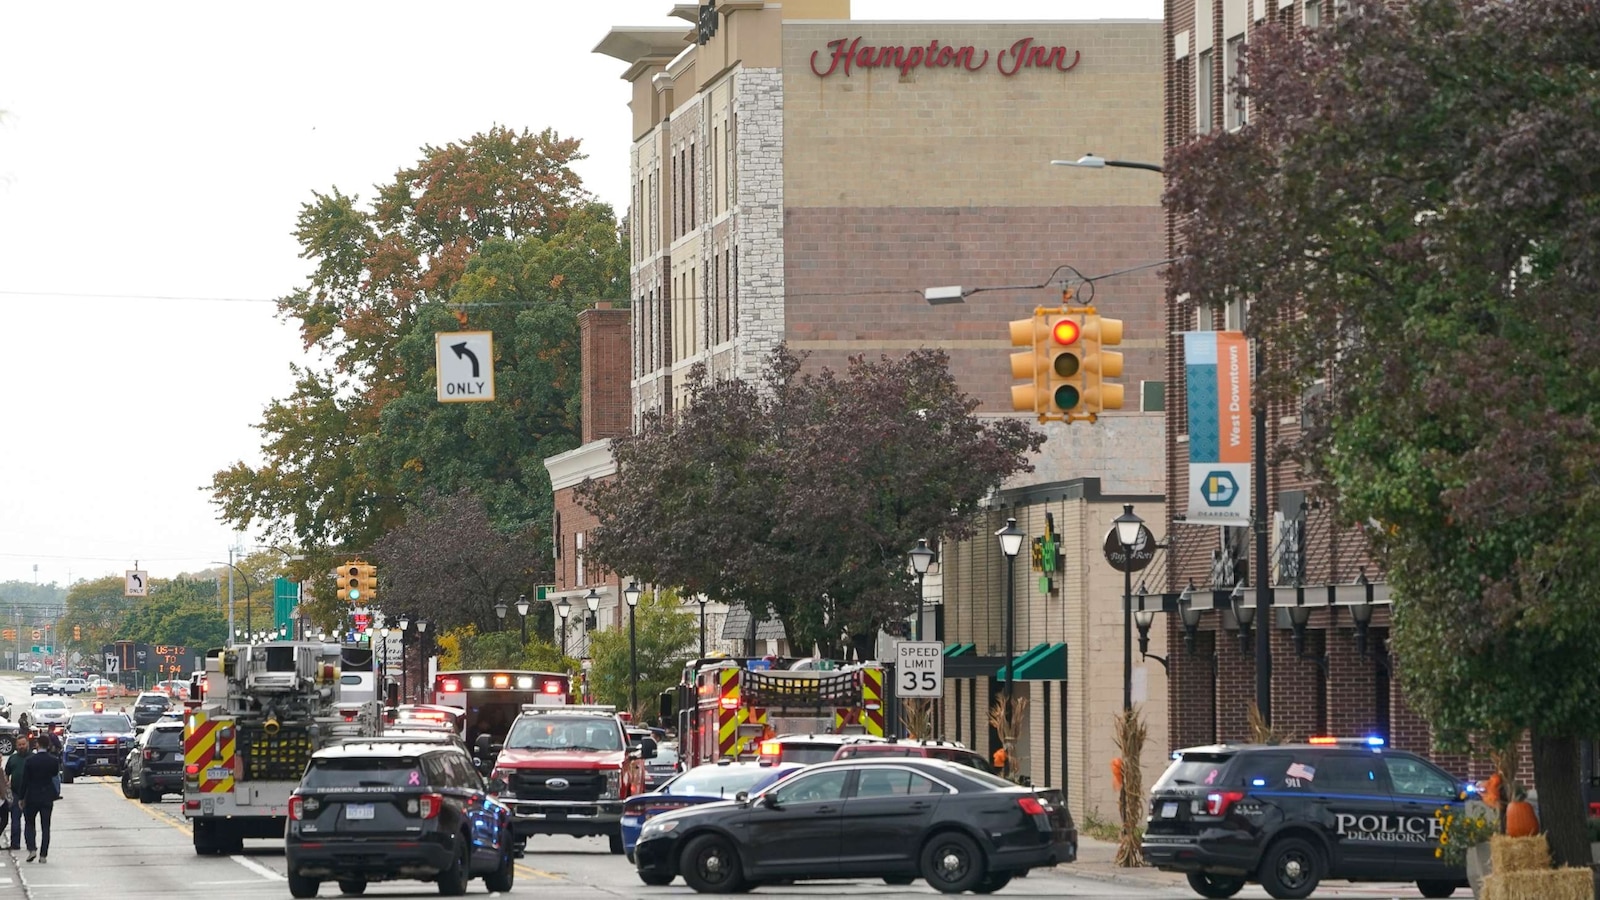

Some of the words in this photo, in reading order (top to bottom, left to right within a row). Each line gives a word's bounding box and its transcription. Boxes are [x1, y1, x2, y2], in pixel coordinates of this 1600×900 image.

[810, 36, 989, 77] Hampton
[997, 37, 1080, 76] Inn
[1229, 345, 1240, 412] Downtown
[446, 382, 485, 395] ONLY
[1229, 415, 1241, 447] West
[156, 646, 185, 655] US-12
[901, 647, 939, 656] SPEED
[165, 655, 176, 664] TO
[904, 659, 935, 669] LIMIT
[170, 665, 181, 673] 94
[903, 671, 936, 691] 35
[1285, 777, 1302, 788] 911
[1348, 831, 1427, 842] DEARBORN
